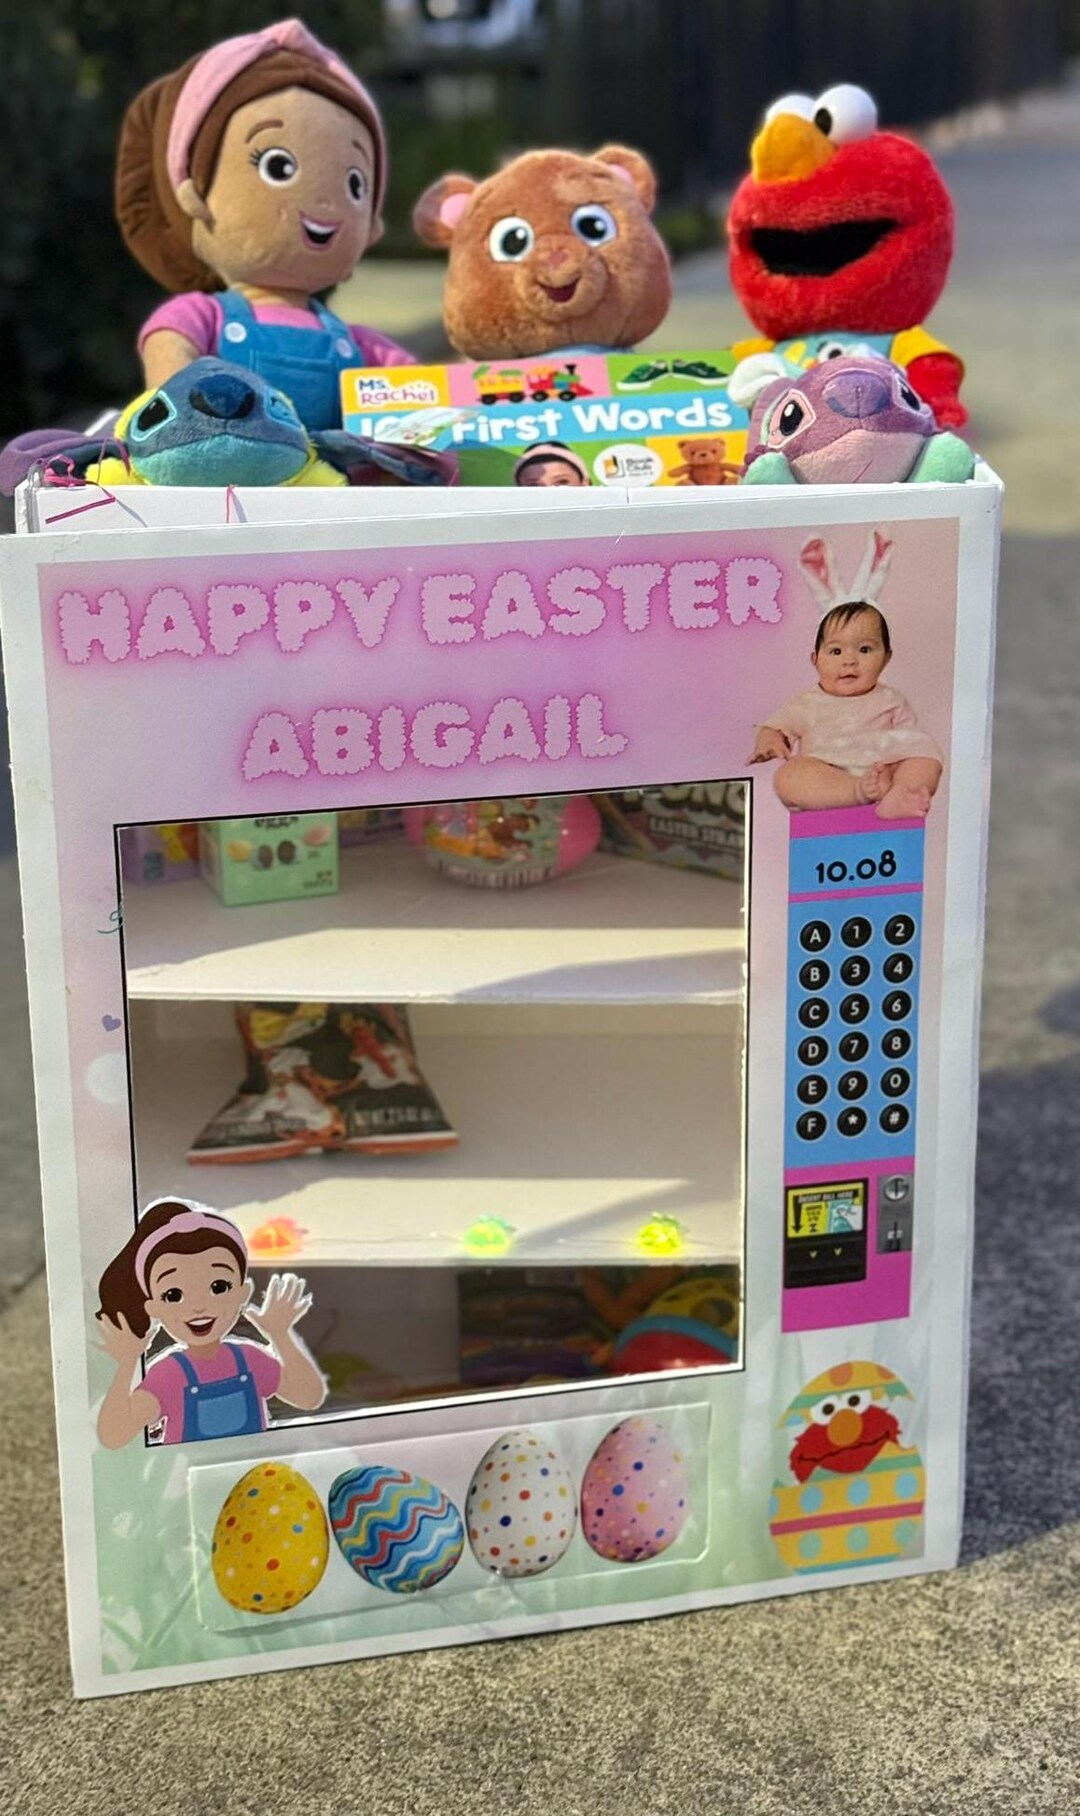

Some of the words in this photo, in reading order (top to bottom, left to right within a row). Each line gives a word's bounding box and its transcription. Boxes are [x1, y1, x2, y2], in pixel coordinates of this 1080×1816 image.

[361, 388, 435, 404] Rachel
[572, 398, 732, 433] Words
[57, 575, 401, 664] HAPPY
[420, 556, 783, 645] EASTER
[241, 692, 630, 782] ABIGAIL
[815, 850, 897, 883] 10.08
[809, 928, 822, 943] A
[853, 925, 860, 939] 1
[895, 922, 905, 937] 2
[810, 967, 820, 982] B
[851, 963, 861, 978] 3
[893, 960, 903, 975] 4
[808, 1004, 820, 1020] C
[850, 1001, 860, 1016] 5
[891, 998, 902, 1013] 6
[808, 1042, 819, 1058] D
[850, 1039, 859, 1054] 7
[891, 1036, 902, 1051] 8
[808, 1080, 818, 1096] E
[848, 1077, 858, 1091] 9
[807, 1117, 817, 1133] F
